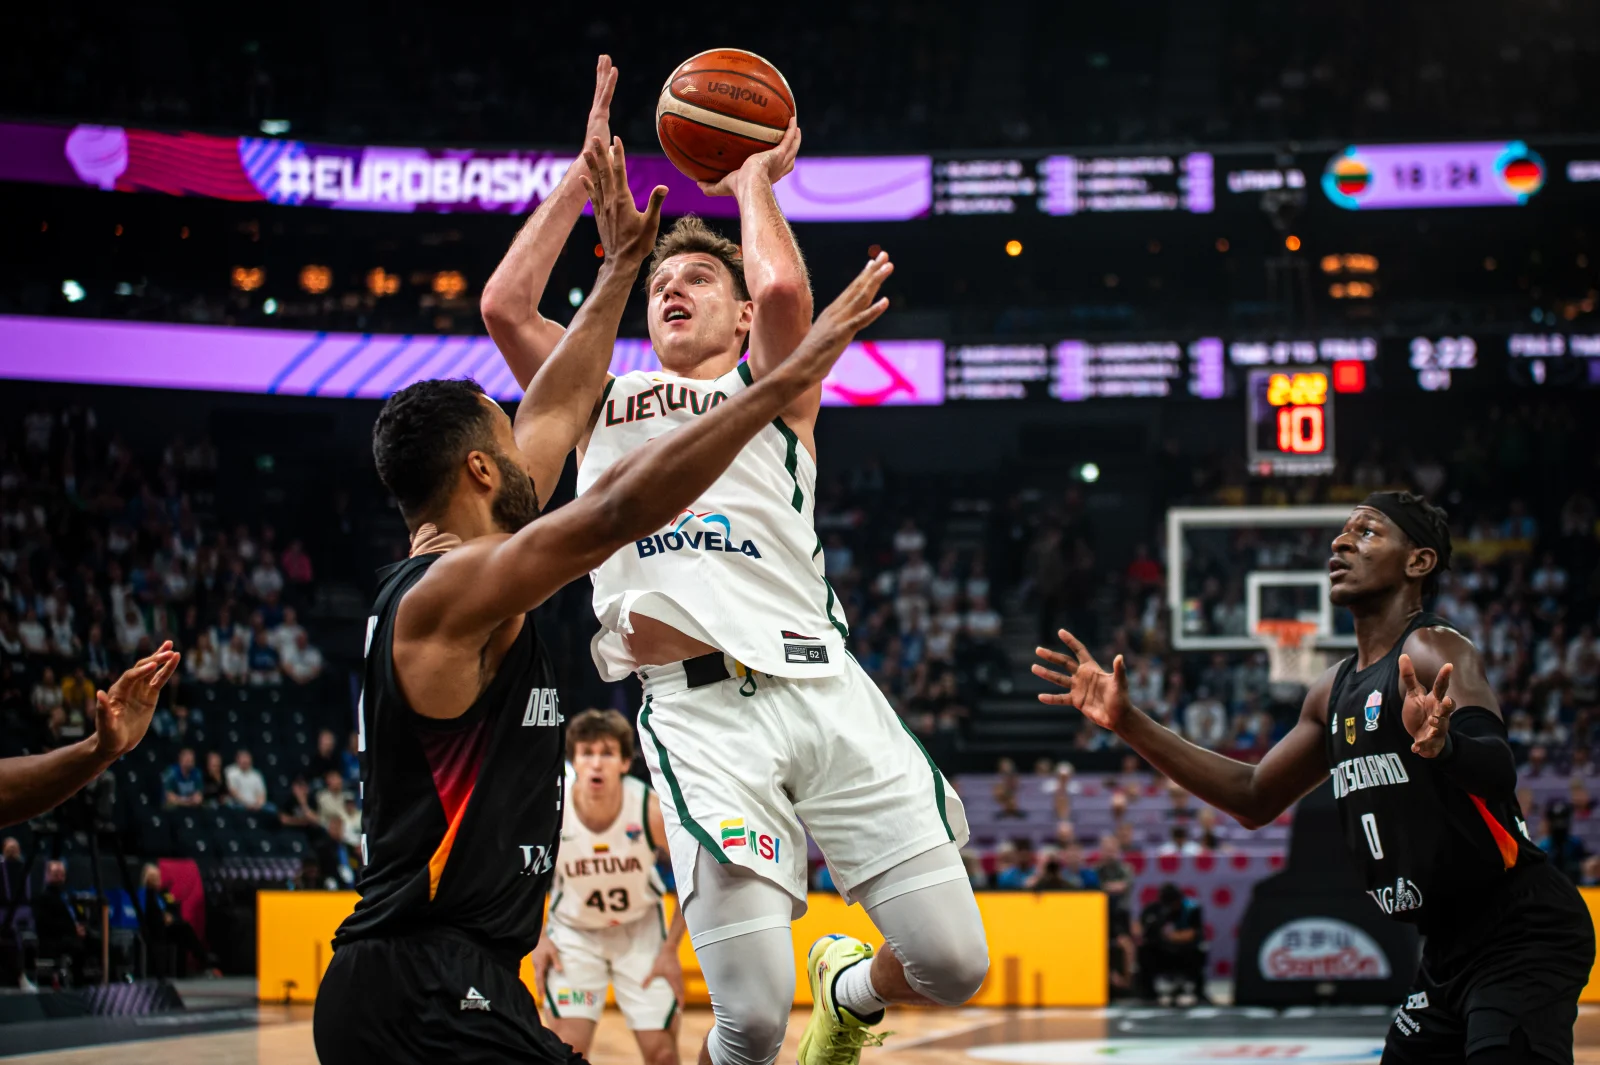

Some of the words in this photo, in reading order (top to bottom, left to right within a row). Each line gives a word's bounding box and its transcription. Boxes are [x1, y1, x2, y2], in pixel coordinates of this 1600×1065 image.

[707, 81, 769, 108] molten
[1277, 405, 1325, 454] 10
[635, 531, 762, 559] BIOVELA
[809, 650, 820, 659] 52
[1361, 812, 1384, 860] 0
[564, 857, 643, 878] LIETUVA
[585, 887, 630, 913] 43
